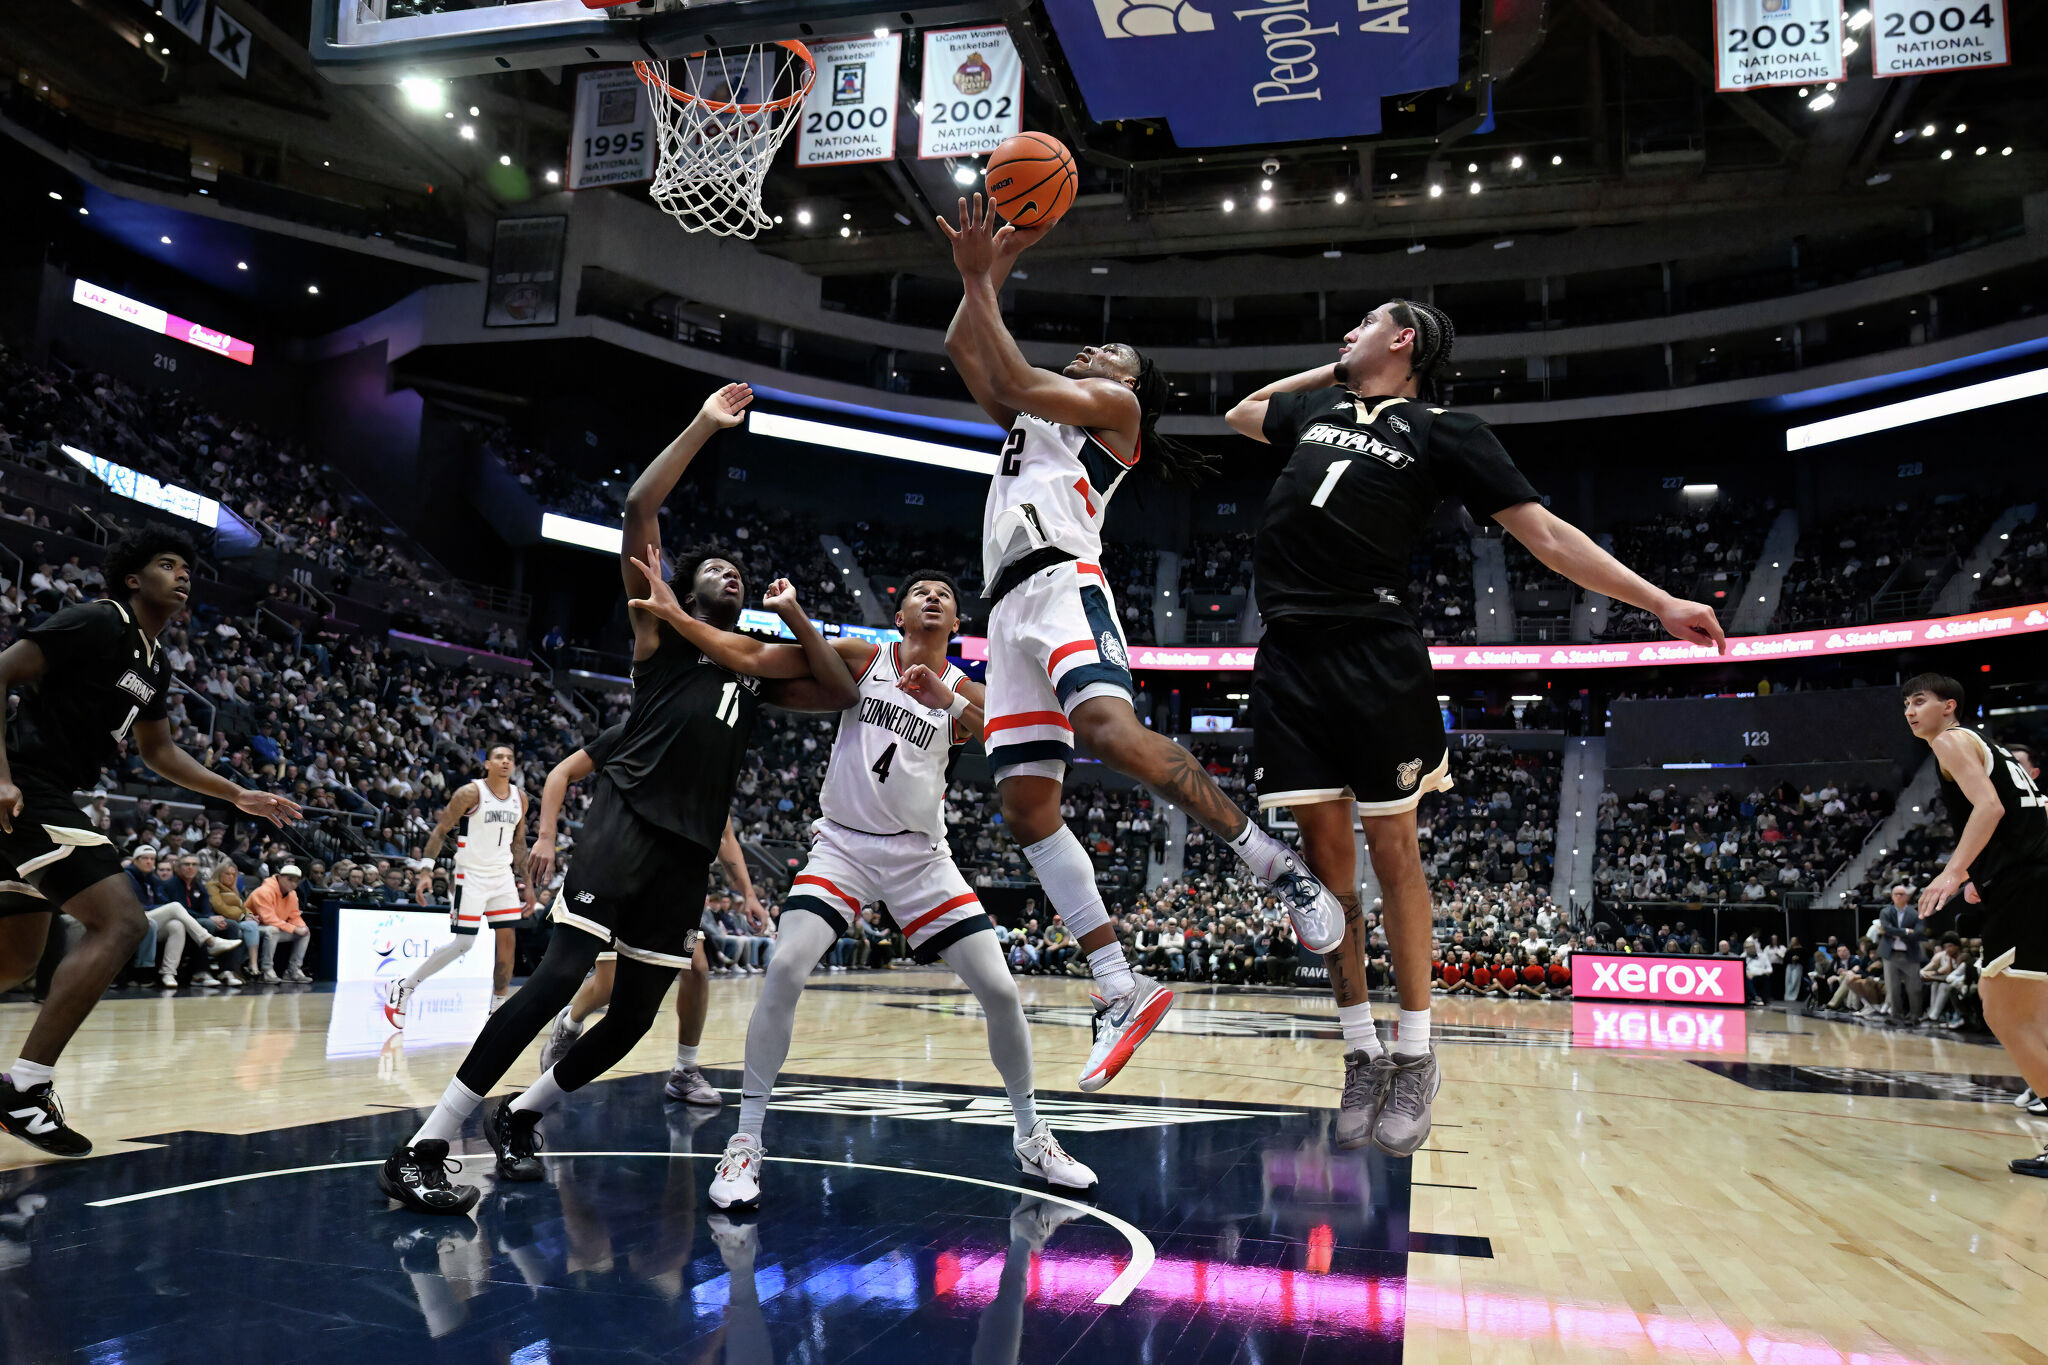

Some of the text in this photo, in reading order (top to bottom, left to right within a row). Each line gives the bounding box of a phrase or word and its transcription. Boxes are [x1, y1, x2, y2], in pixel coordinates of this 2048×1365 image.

[1884, 3, 1994, 38] 2004
[936, 29, 1008, 42] UConn Women
[1728, 20, 1829, 53] 2003
[949, 40, 1000, 52] Basketball
[1897, 36, 1984, 53] NATIONAL
[828, 51, 875, 63] Basketball
[1233, 0, 1340, 107] Peopl
[1739, 52, 1822, 68] NATIONAL
[1890, 51, 1993, 70] CHAMPIONS
[1732, 66, 1829, 84] CHAMPIONS
[930, 96, 1012, 125] 2002
[806, 107, 888, 134] 2000
[815, 134, 878, 147] NATIONAL
[938, 125, 1004, 139] NATIONAL
[585, 132, 645, 158] 1995
[808, 147, 882, 162] CHAMPIONS
[584, 158, 641, 172] NATIONAL
[579, 169, 644, 186] CHAMPIONS
[154, 353, 177, 372] 219
[1303, 424, 1403, 464] BRYANT
[728, 466, 747, 482] 221
[1661, 476, 1685, 489] 227
[1310, 459, 1352, 508] 1
[1946, 617, 2012, 637] State Farm
[1845, 629, 1913, 646] State Farm
[1657, 647, 1689, 659] State
[1750, 639, 1814, 655] State Farm
[1482, 651, 1541, 664] State Farm
[1569, 650, 1628, 663] State Farm
[715, 681, 741, 728] 11
[859, 696, 938, 751] CONNECTICUT
[1461, 734, 1485, 748] 122
[1742, 730, 1770, 747] 123
[871, 742, 898, 784] 4
[498, 826, 504, 846] 1
[1591, 962, 1724, 997] xerox
